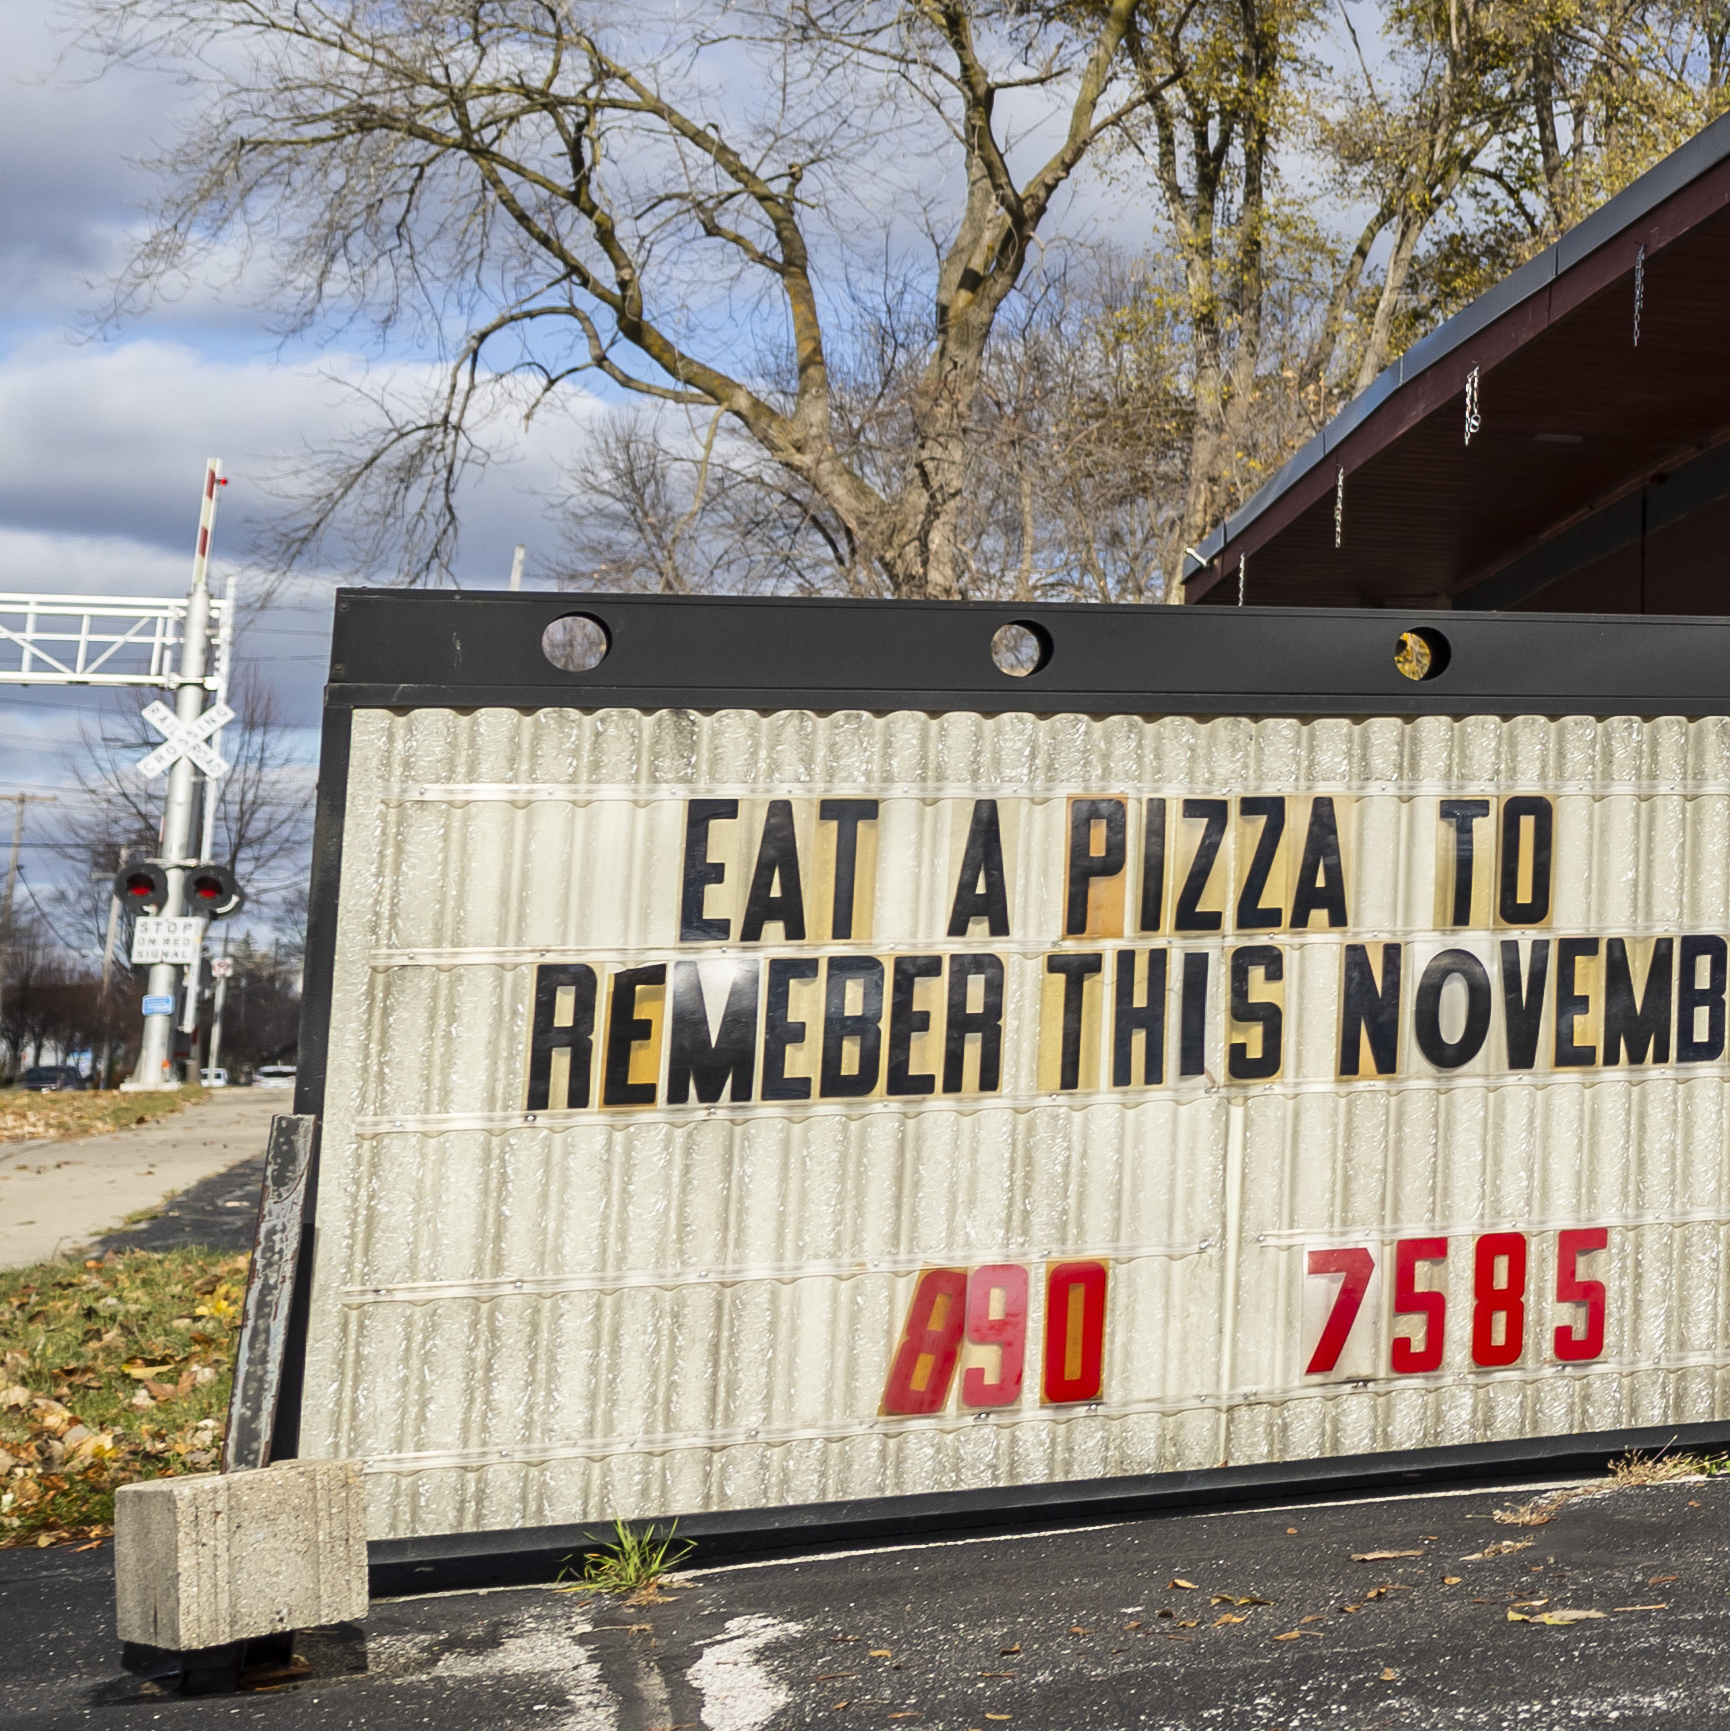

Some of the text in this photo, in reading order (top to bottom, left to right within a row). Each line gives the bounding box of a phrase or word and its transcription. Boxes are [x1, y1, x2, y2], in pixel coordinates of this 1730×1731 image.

[680, 795, 1553, 941] EAT A PIZZA TO
[136, 949, 188, 960] SIGNAL
[138, 937, 191, 948] ON RED
[140, 920, 193, 935] STOP
[527, 952, 1004, 1111] REMEBER
[1047, 943, 1284, 1091] THIS
[884, 1227, 1608, 1414] 890 7585
